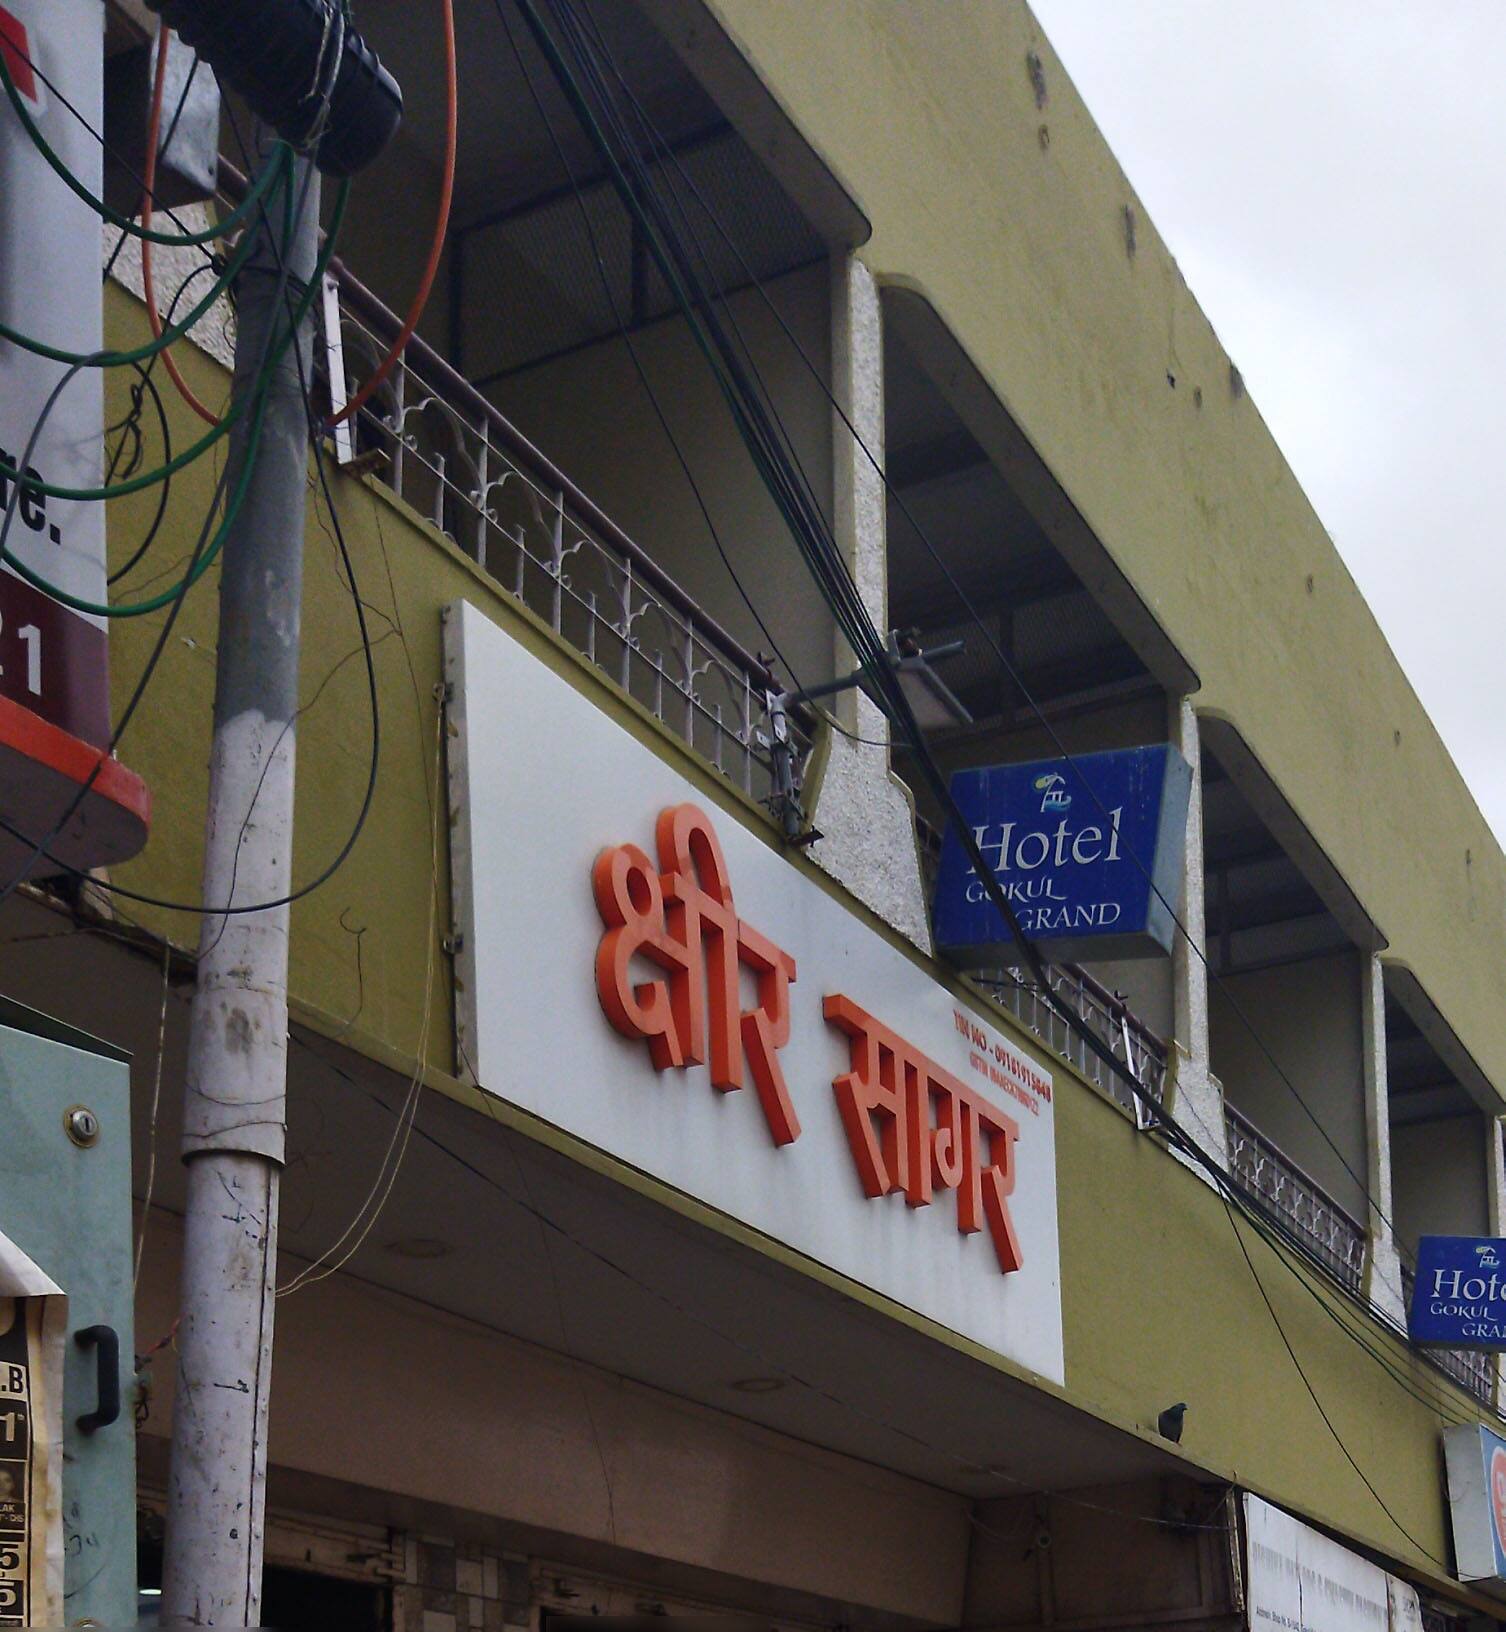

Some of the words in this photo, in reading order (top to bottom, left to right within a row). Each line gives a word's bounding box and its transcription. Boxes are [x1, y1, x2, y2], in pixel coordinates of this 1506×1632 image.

[966, 807, 1123, 874] Hotel
[1015, 902, 1121, 931] GRAND
[592, 802, 802, 1147] क्षीर
[823, 994, 1024, 1273] सागर
[1430, 1301, 1499, 1322] GOKUL
